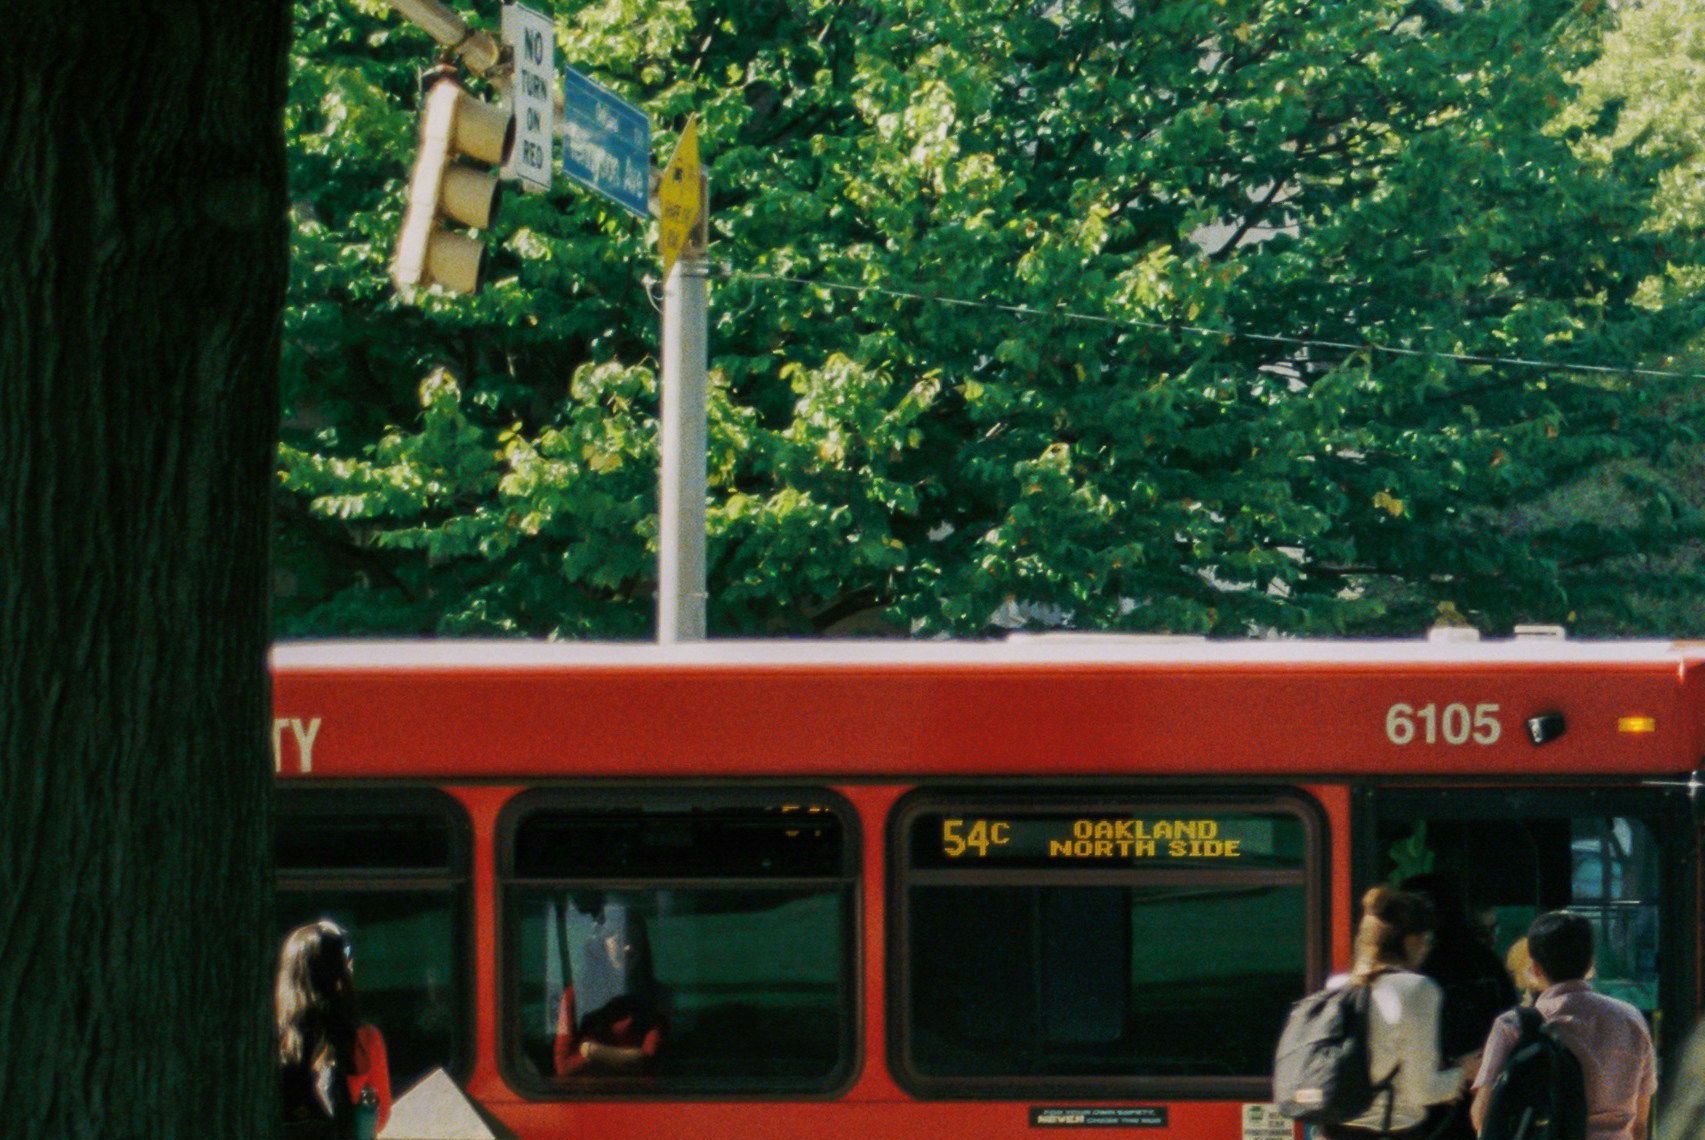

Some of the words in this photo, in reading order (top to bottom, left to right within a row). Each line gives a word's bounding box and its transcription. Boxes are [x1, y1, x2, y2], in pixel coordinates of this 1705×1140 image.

[524, 26, 543, 66] NO
[521, 69, 548, 101] TURN
[526, 106, 541, 133] ON
[522, 139, 543, 170] RED
[1385, 702, 1501, 745] 6105
[943, 820, 1010, 857] 54C
[1073, 820, 1218, 840] OAKLAND
[1049, 840, 1155, 857] NORTH
[1168, 840, 1241, 857] SIDE
[1037, 1115, 1085, 1124] NEVER
